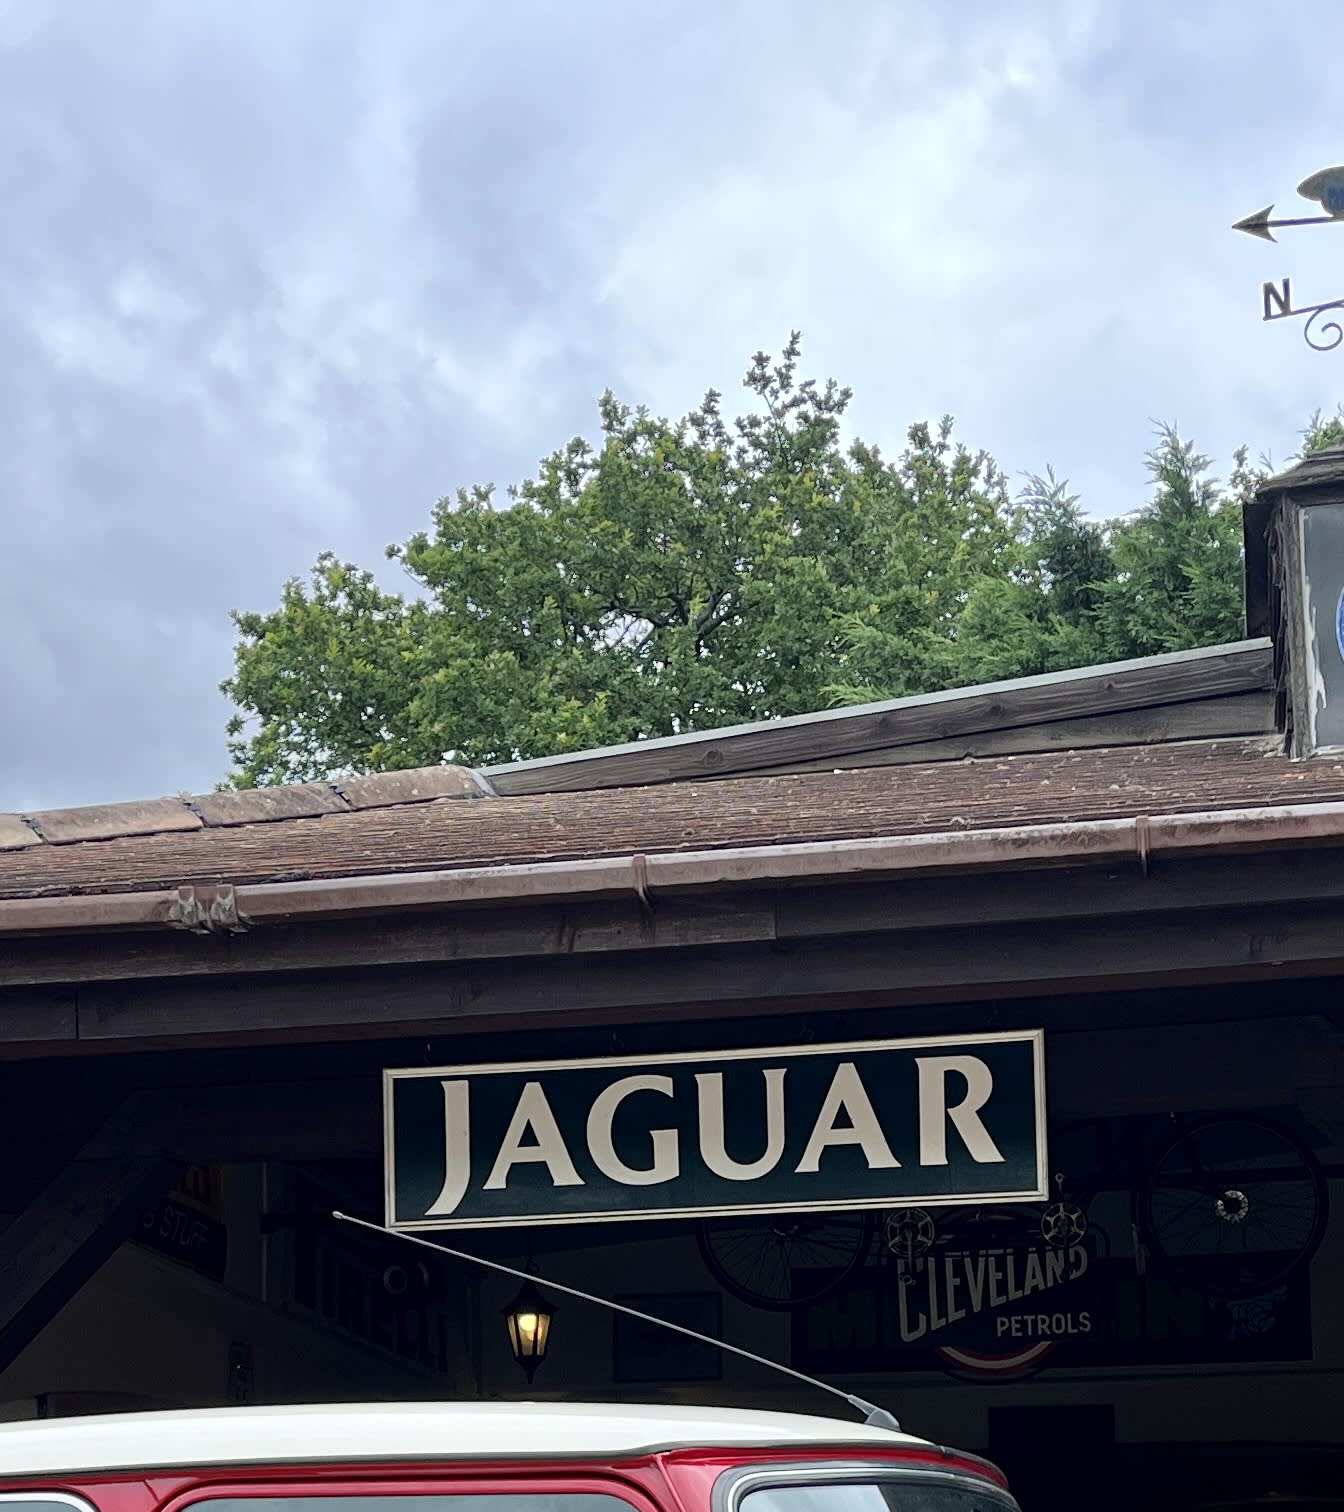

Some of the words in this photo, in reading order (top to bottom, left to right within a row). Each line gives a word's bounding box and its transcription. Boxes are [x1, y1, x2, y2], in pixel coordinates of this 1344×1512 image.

[1263, 278, 1291, 321] N
[423, 1054, 1007, 1217] JAGUAR
[897, 1245, 1089, 1343] CLEVELAND
[997, 1311, 1092, 1338] PETROLS
